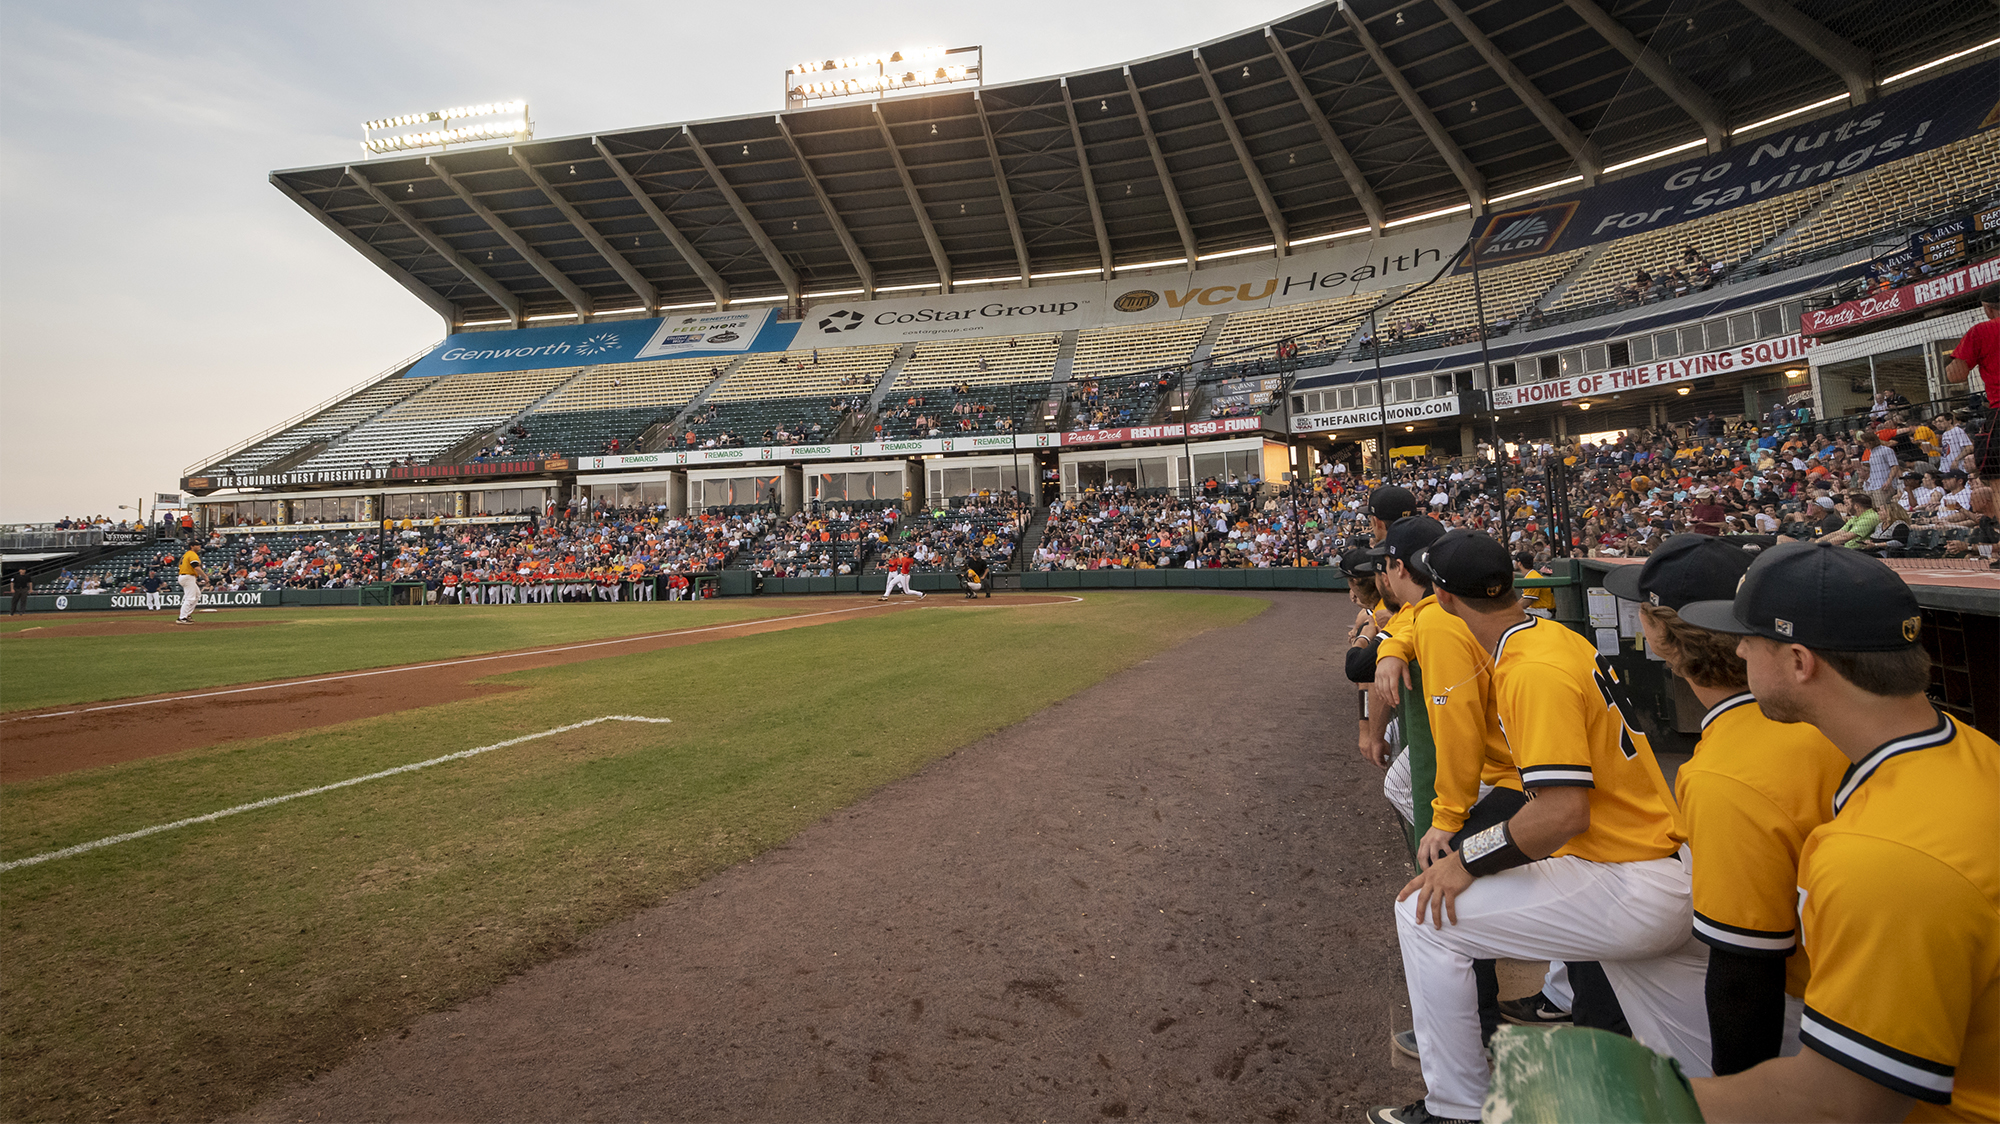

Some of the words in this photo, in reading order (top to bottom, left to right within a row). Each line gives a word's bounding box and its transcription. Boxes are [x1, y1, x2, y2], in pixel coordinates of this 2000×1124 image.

[1662, 163, 1732, 192] Go
[1748, 111, 1885, 167] Nuts
[1591, 205, 1675, 236] For
[1684, 119, 1933, 215] Savings!
[1482, 234, 1544, 254] ALDI
[1164, 278, 1280, 309] VCU
[1282, 248, 1441, 296] Health
[1914, 270, 1966, 305] RENT
[874, 309, 977, 325] CoStar
[980, 301, 1079, 317] Group
[1812, 308, 1855, 329] Party
[1860, 291, 1901, 316] Deck
[709, 322, 747, 330] MORE
[902, 326, 984, 335] costargroup.com
[441, 341, 571, 361] Genworth
[1517, 381, 1571, 404] HOME
[1578, 375, 1602, 394] OF
[1609, 367, 1650, 388] THE
[1656, 352, 1733, 381] FLYING
[1068, 432, 1096, 442] Party
[1099, 430, 1122, 440] Deck
[1130, 426, 1163, 439] RENT
[217, 477, 233, 487] THE
[236, 474, 288, 486] SQUIRRELS
[291, 472, 315, 483] NEST
[318, 469, 372, 482] PRESENTED
[375, 468, 388, 479] BY
[391, 467, 409, 478] THE
[413, 465, 460, 477] ORIGINAL
[464, 463, 496, 475] RETRO
[500, 461, 535, 473] BRAND
[57, 598, 66, 607] 42
[111, 592, 262, 607] SQUIRLSBBALL.COM
